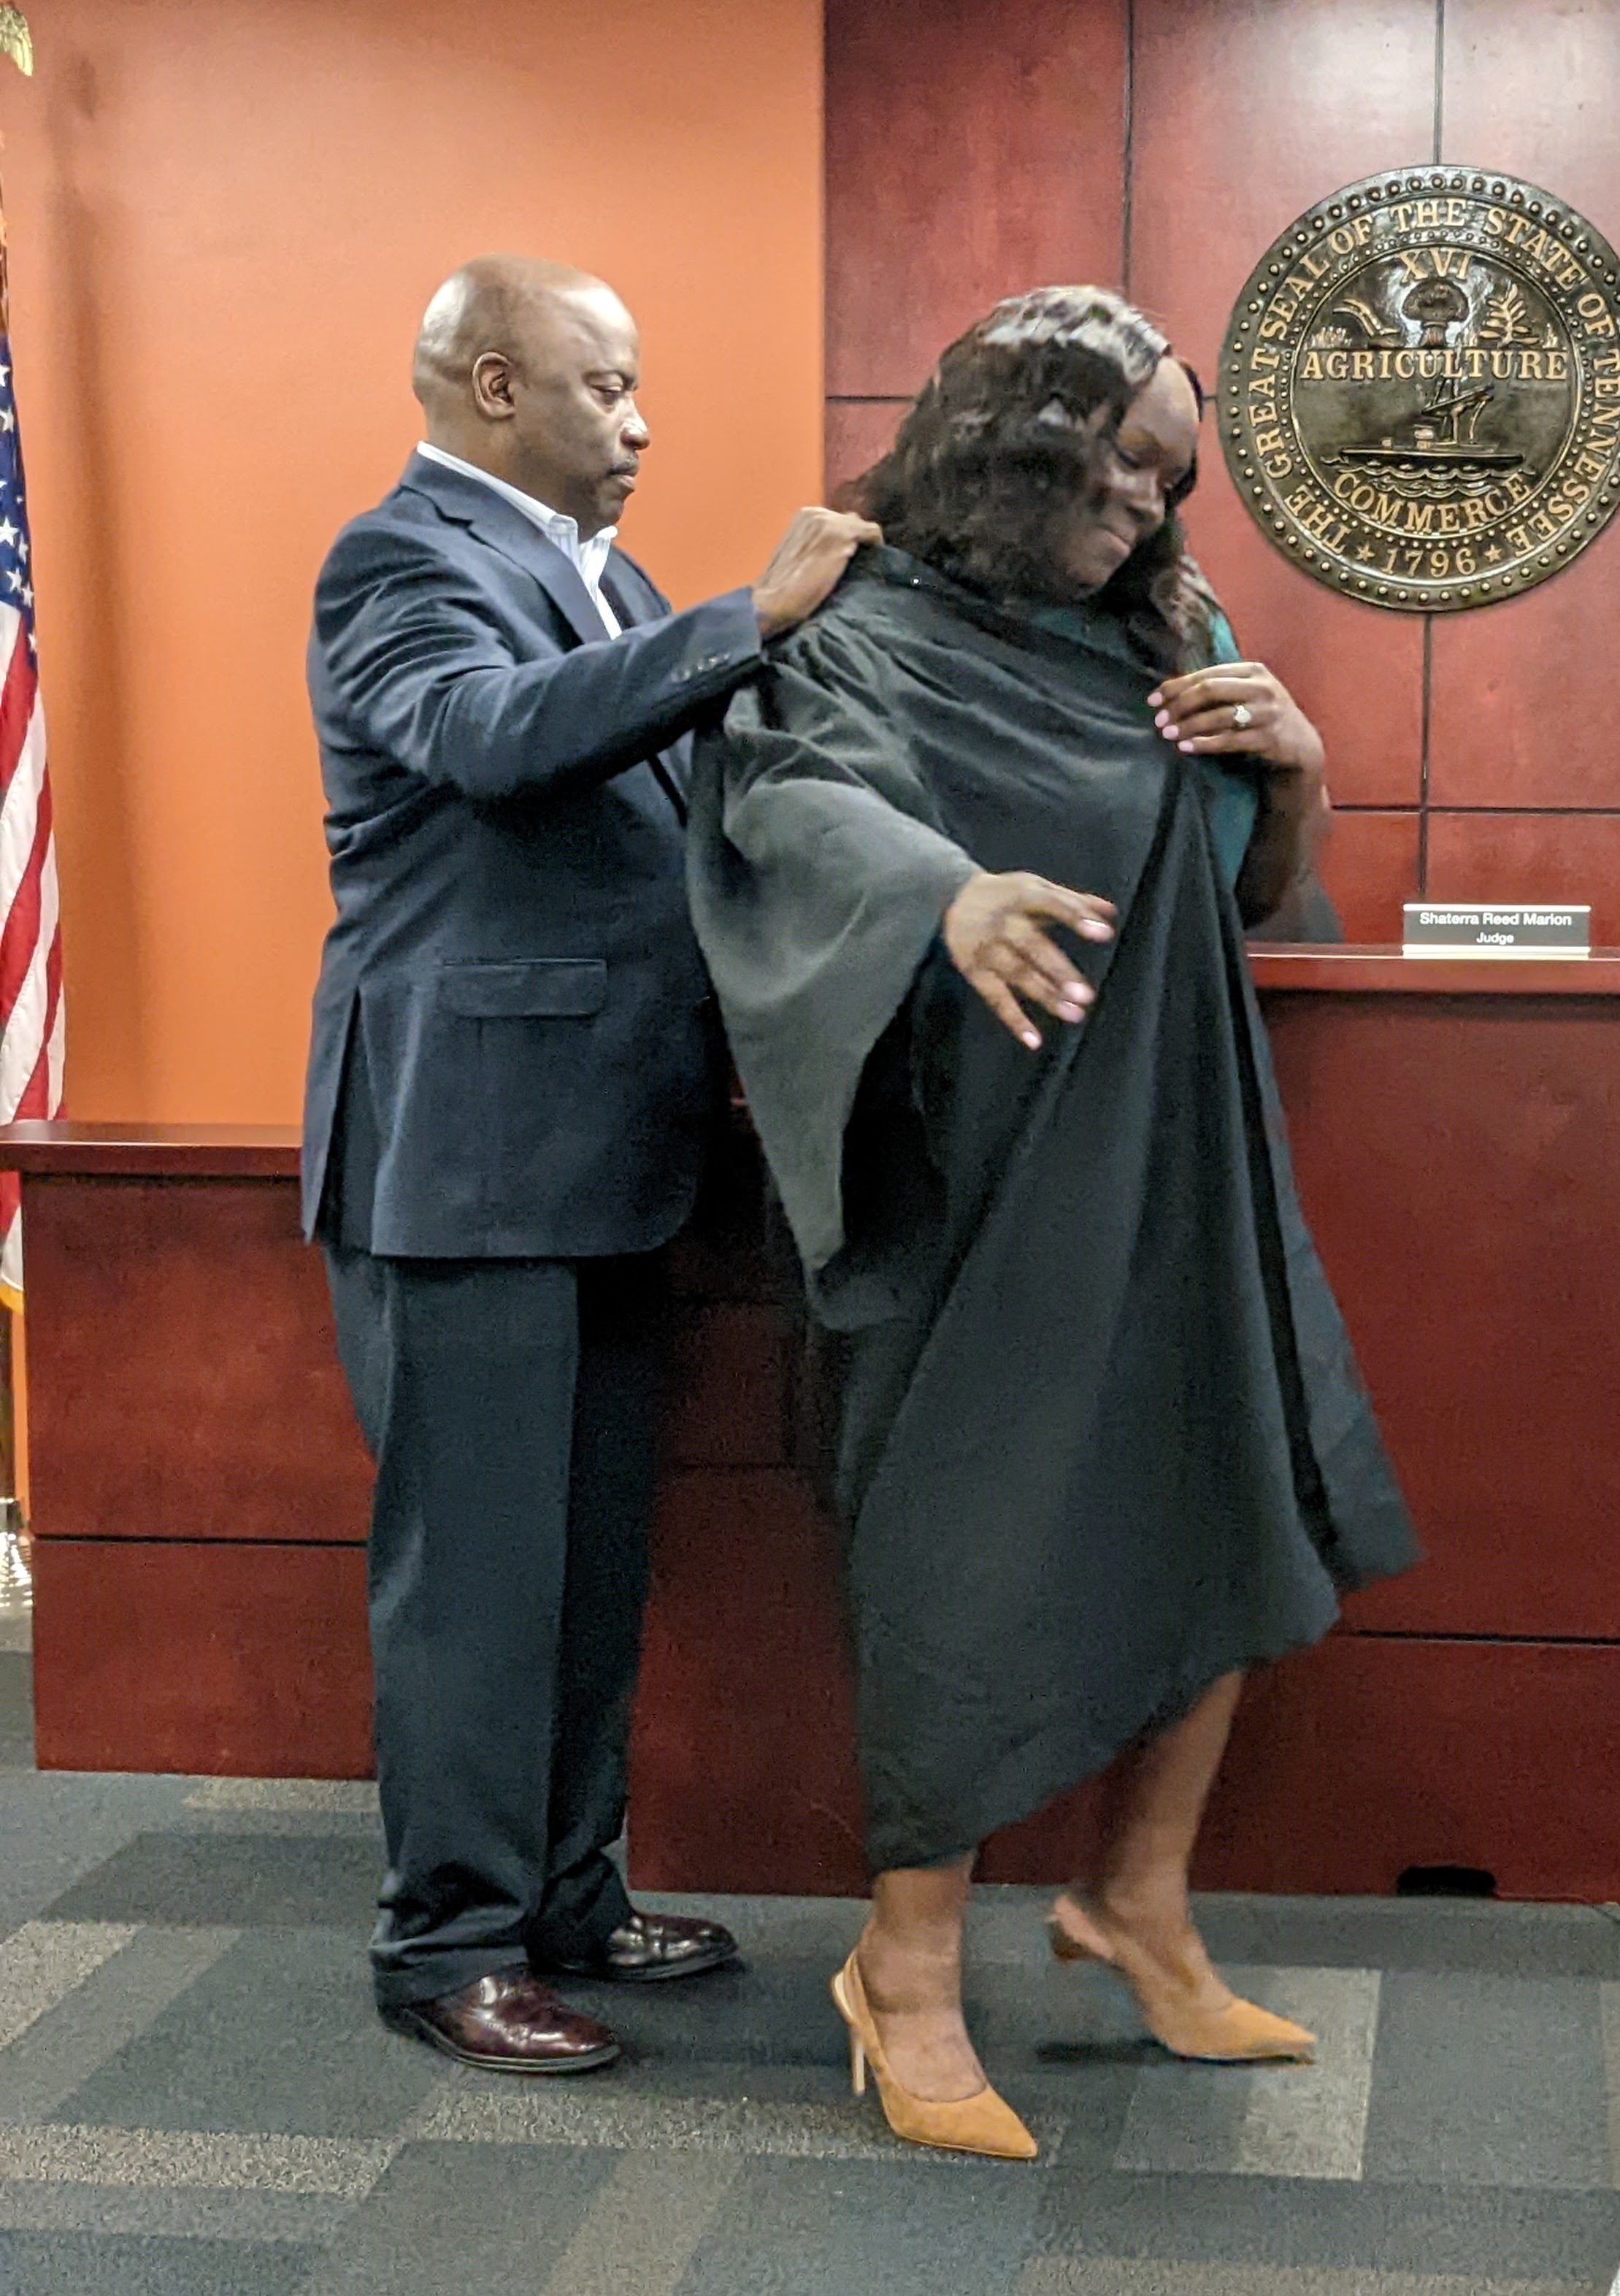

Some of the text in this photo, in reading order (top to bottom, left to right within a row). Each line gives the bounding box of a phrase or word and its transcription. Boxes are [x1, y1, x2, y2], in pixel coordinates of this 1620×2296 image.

[1397, 245, 1475, 283] XVI
[1248, 198, 1620, 557] THE GREAT SEAL OF THE STATE OF TENNESSEE
[1300, 349, 1568, 380] AGRICULTURE
[1334, 472, 1533, 534] COMMERCE
[1384, 549, 1476, 578] 1796
[1419, 912, 1572, 926] Shaterra Reed Marion
[1475, 932, 1515, 945] Judge
